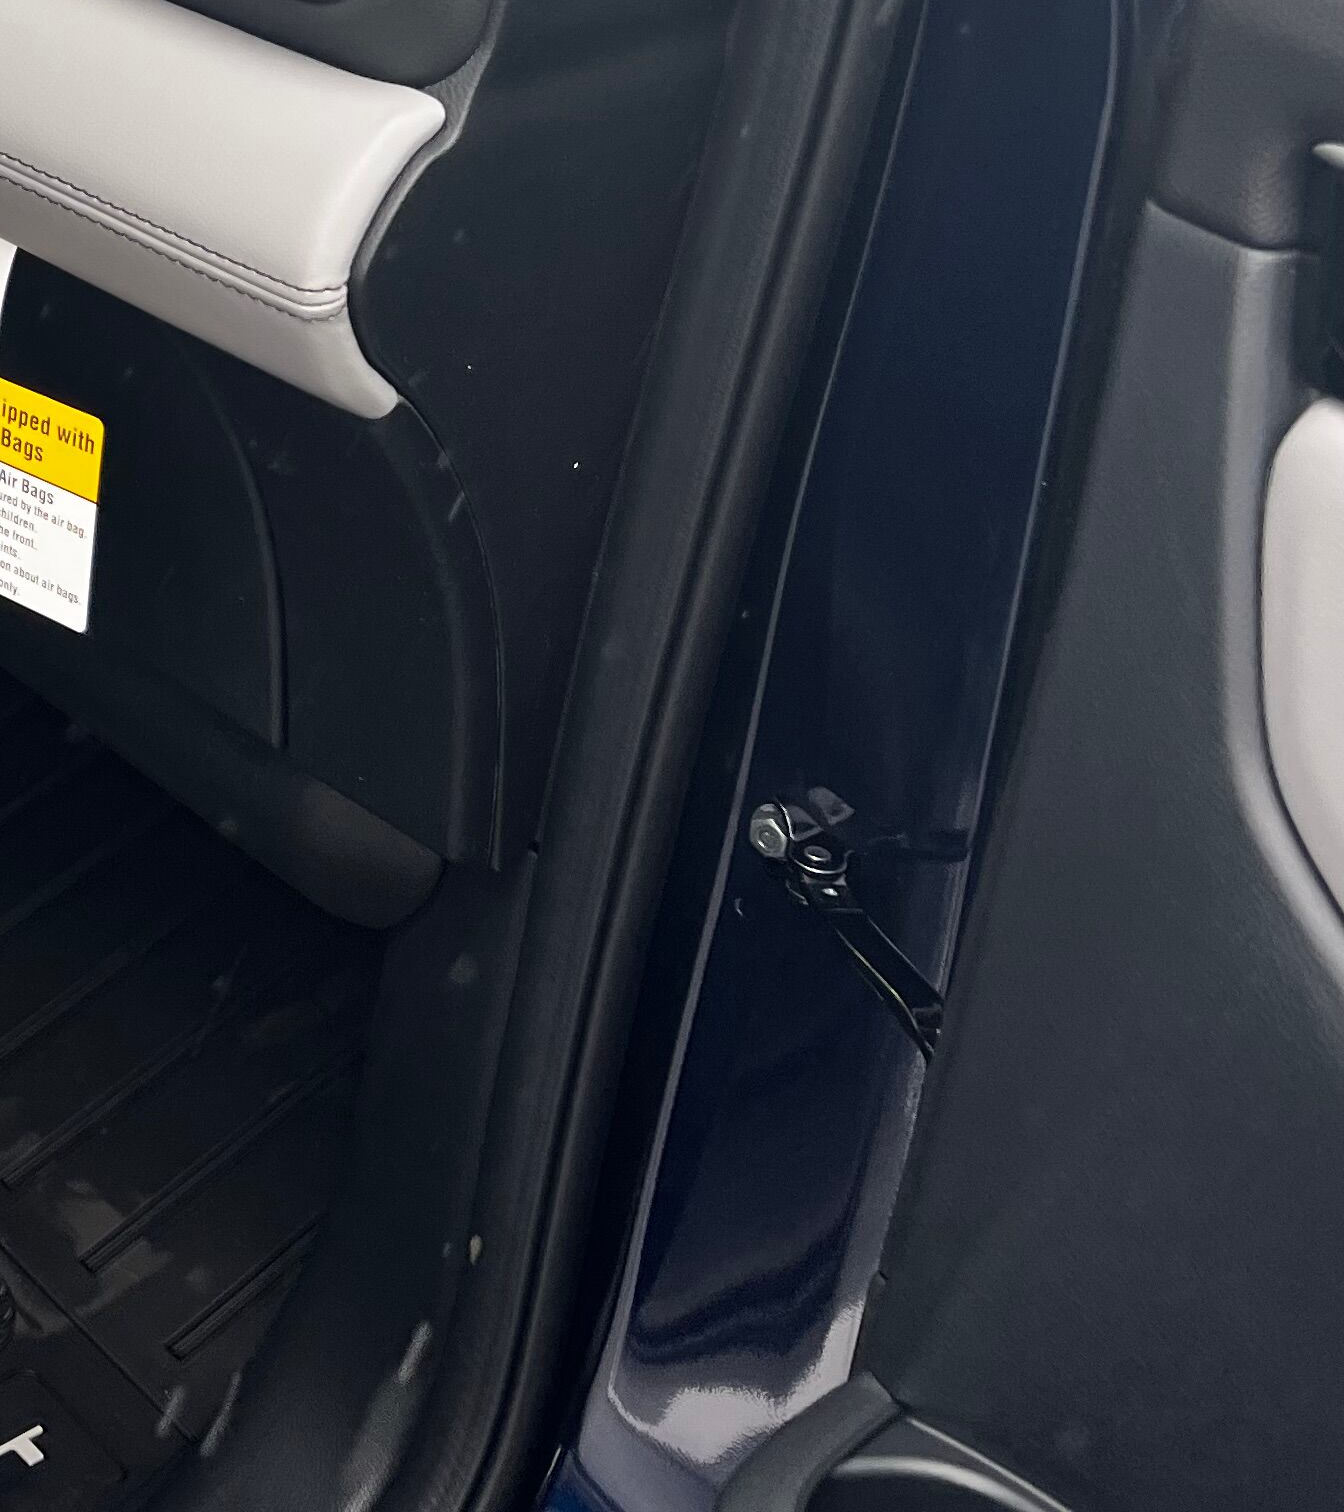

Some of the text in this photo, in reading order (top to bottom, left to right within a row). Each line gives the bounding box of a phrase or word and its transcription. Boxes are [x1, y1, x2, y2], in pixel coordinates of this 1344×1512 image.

[0, 426, 44, 462] Bags
[57, 425, 95, 455] with
[21, 477, 55, 505] Bags
[20, 499, 32, 515] by
[33, 506, 49, 521] the
[50, 515, 65, 528] air
[13, 566, 39, 585] about
[41, 579, 55, 592] air
